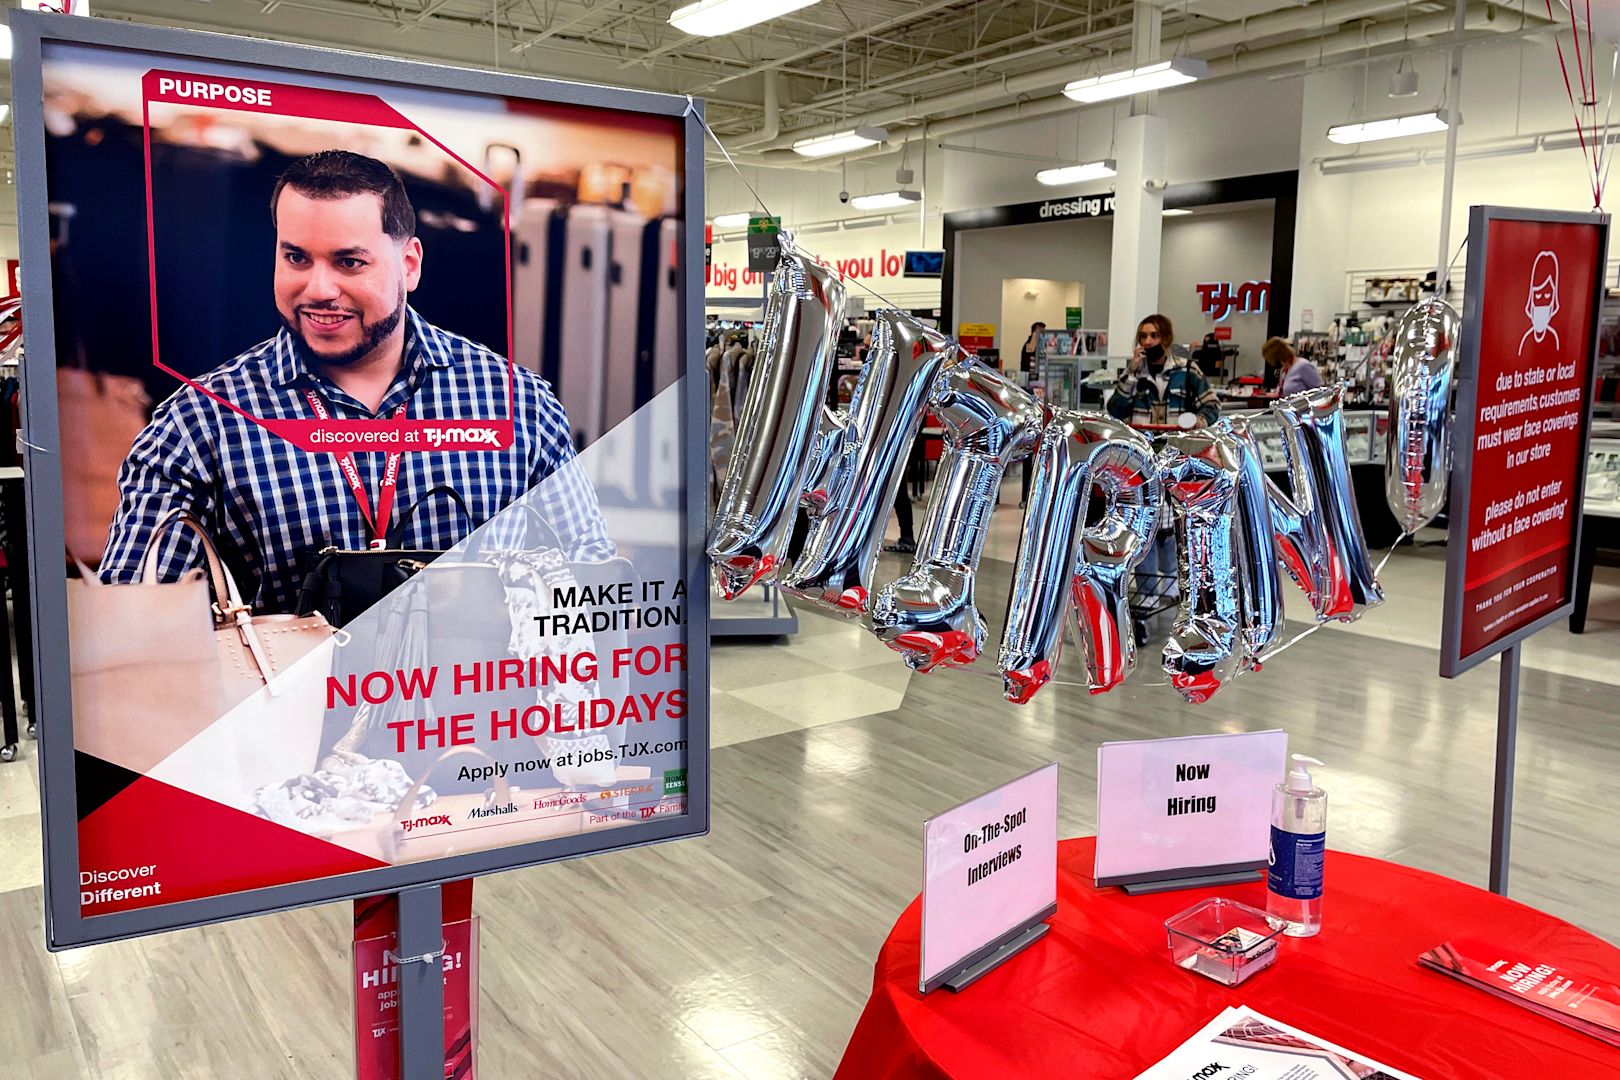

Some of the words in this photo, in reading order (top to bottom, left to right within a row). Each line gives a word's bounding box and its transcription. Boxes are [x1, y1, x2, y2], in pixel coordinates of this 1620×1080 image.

[160, 78, 272, 106] PURPOSE
[1039, 197, 1101, 218] dressing
[714, 262, 737, 291] big
[836, 257, 873, 283] you
[1495, 372, 1512, 392] due
[1514, 370, 1522, 388] to
[1523, 367, 1545, 386] state
[1546, 367, 1556, 382] or
[1557, 361, 1576, 380] local
[1480, 394, 1538, 424] requirements,
[1540, 387, 1580, 409] customers
[309, 428, 400, 443] discovered
[404, 429, 420, 443] at
[1477, 427, 1502, 451] must
[1503, 425, 1523, 444] wear
[1523, 419, 1541, 438] face
[1542, 411, 1579, 433] coverings
[1506, 451, 1515, 469] in
[1515, 449, 1530, 466] our
[1530, 443, 1551, 461] store
[1485, 500, 1513, 525] please
[1514, 491, 1524, 510] do
[1526, 484, 1540, 504] not
[1541, 480, 1563, 499] enter
[1472, 523, 1506, 552] without
[1507, 526, 1512, 538] a
[1513, 516, 1531, 535] face
[553, 583, 633, 609] MAKE
[642, 581, 664, 602] IT
[672, 579, 688, 600] A
[1475, 598, 1493, 612] THANK
[1493, 592, 1503, 604] YOU
[1503, 586, 1512, 597] FOR
[1513, 580, 1525, 593] YOUR
[1526, 565, 1557, 586] COOPERATION
[533, 605, 688, 637] TRADITION.
[326, 666, 438, 709] NOW
[453, 652, 598, 695] HIRING
[612, 643, 688, 679] FOR
[387, 713, 475, 753] THE
[491, 689, 688, 741] HOLIDAYS
[458, 761, 508, 782] Apply
[514, 758, 550, 773] now
[557, 754, 573, 767] at
[577, 739, 688, 767] jobs.TJX.com
[1176, 764, 1210, 782] Now
[665, 781, 686, 789] SENSE
[467, 802, 518, 820] Marshalls
[533, 793, 587, 810] HomeGoods
[613, 784, 653, 798] SIERRA
[589, 814, 608, 824] Part
[611, 812, 621, 820] of
[622, 811, 637, 819] the
[640, 806, 656, 819] TJX
[660, 802, 688, 814] Family
[1168, 795, 1216, 816] Hiring
[964, 807, 1026, 853] On-The-Spot
[79, 865, 157, 886] Discover
[968, 844, 1021, 886] Interviews
[80, 881, 161, 906] Different
[1500, 962, 1532, 982] NOW
[1509, 964, 1557, 993] HIRING!
